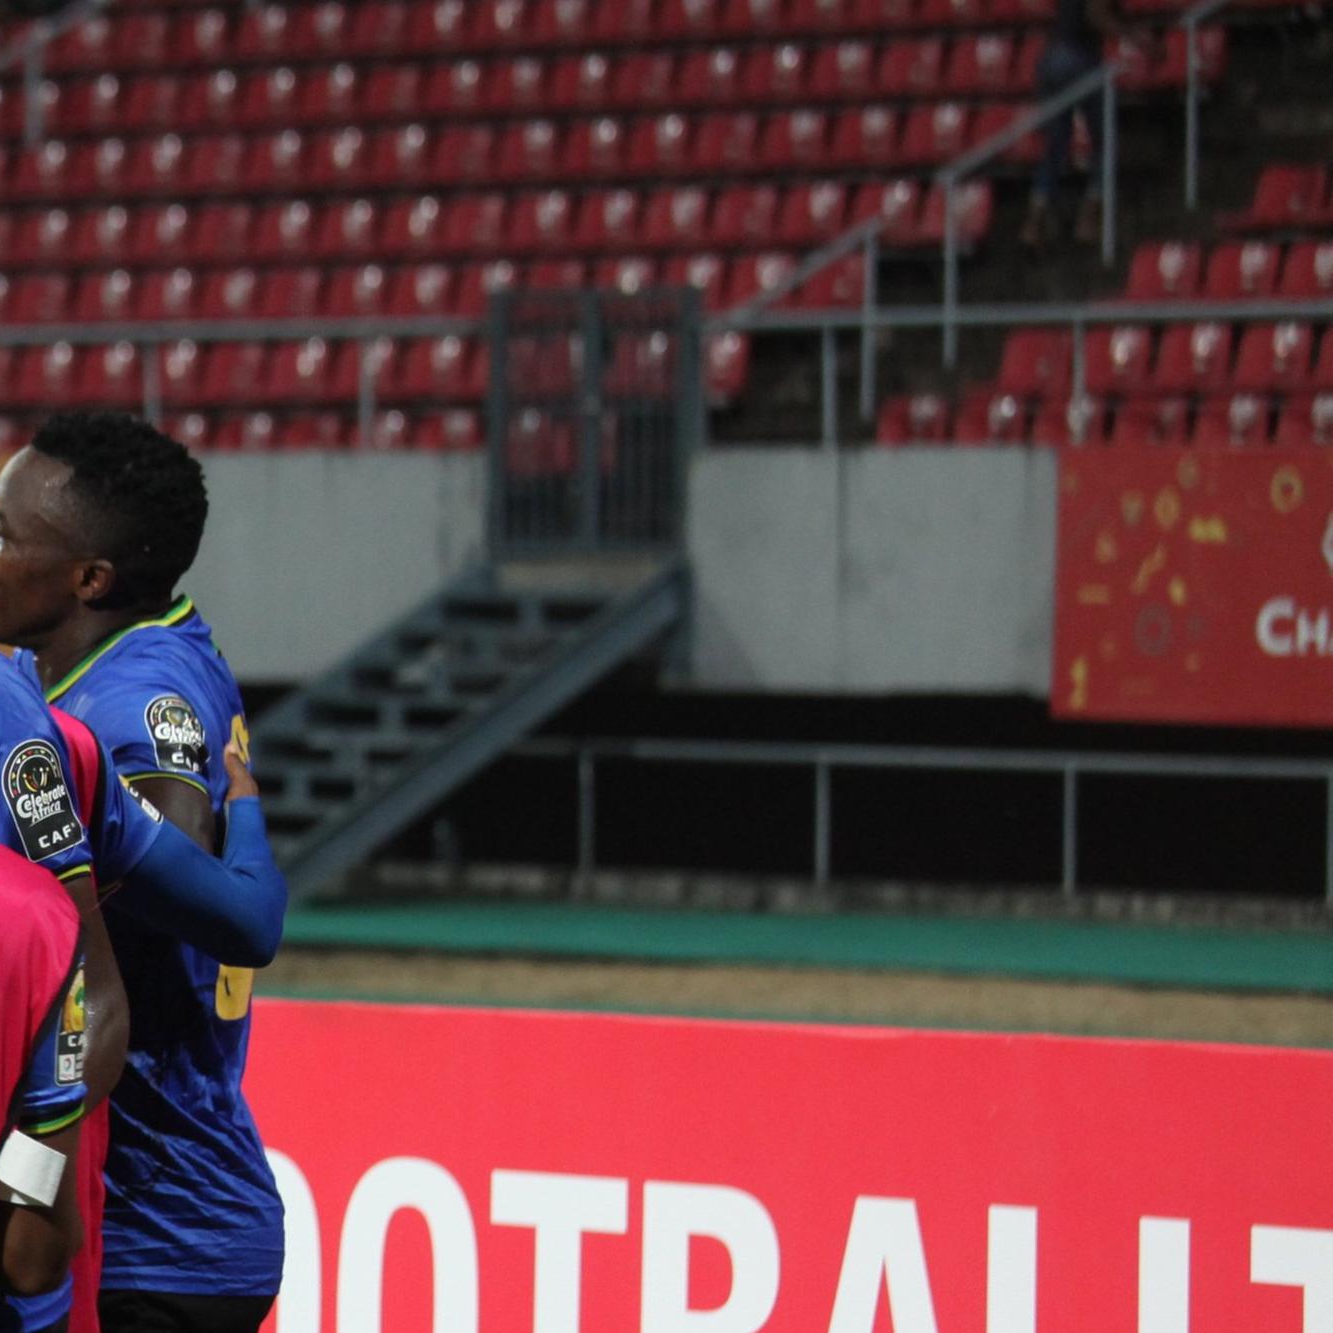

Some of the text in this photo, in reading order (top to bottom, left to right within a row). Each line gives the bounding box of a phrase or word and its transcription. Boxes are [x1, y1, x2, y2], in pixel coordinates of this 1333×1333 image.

[1256, 597, 1333, 657] CH
[16, 784, 66, 818] Celebrate
[31, 800, 61, 824] Africa
[38, 824, 72, 849] CAF
